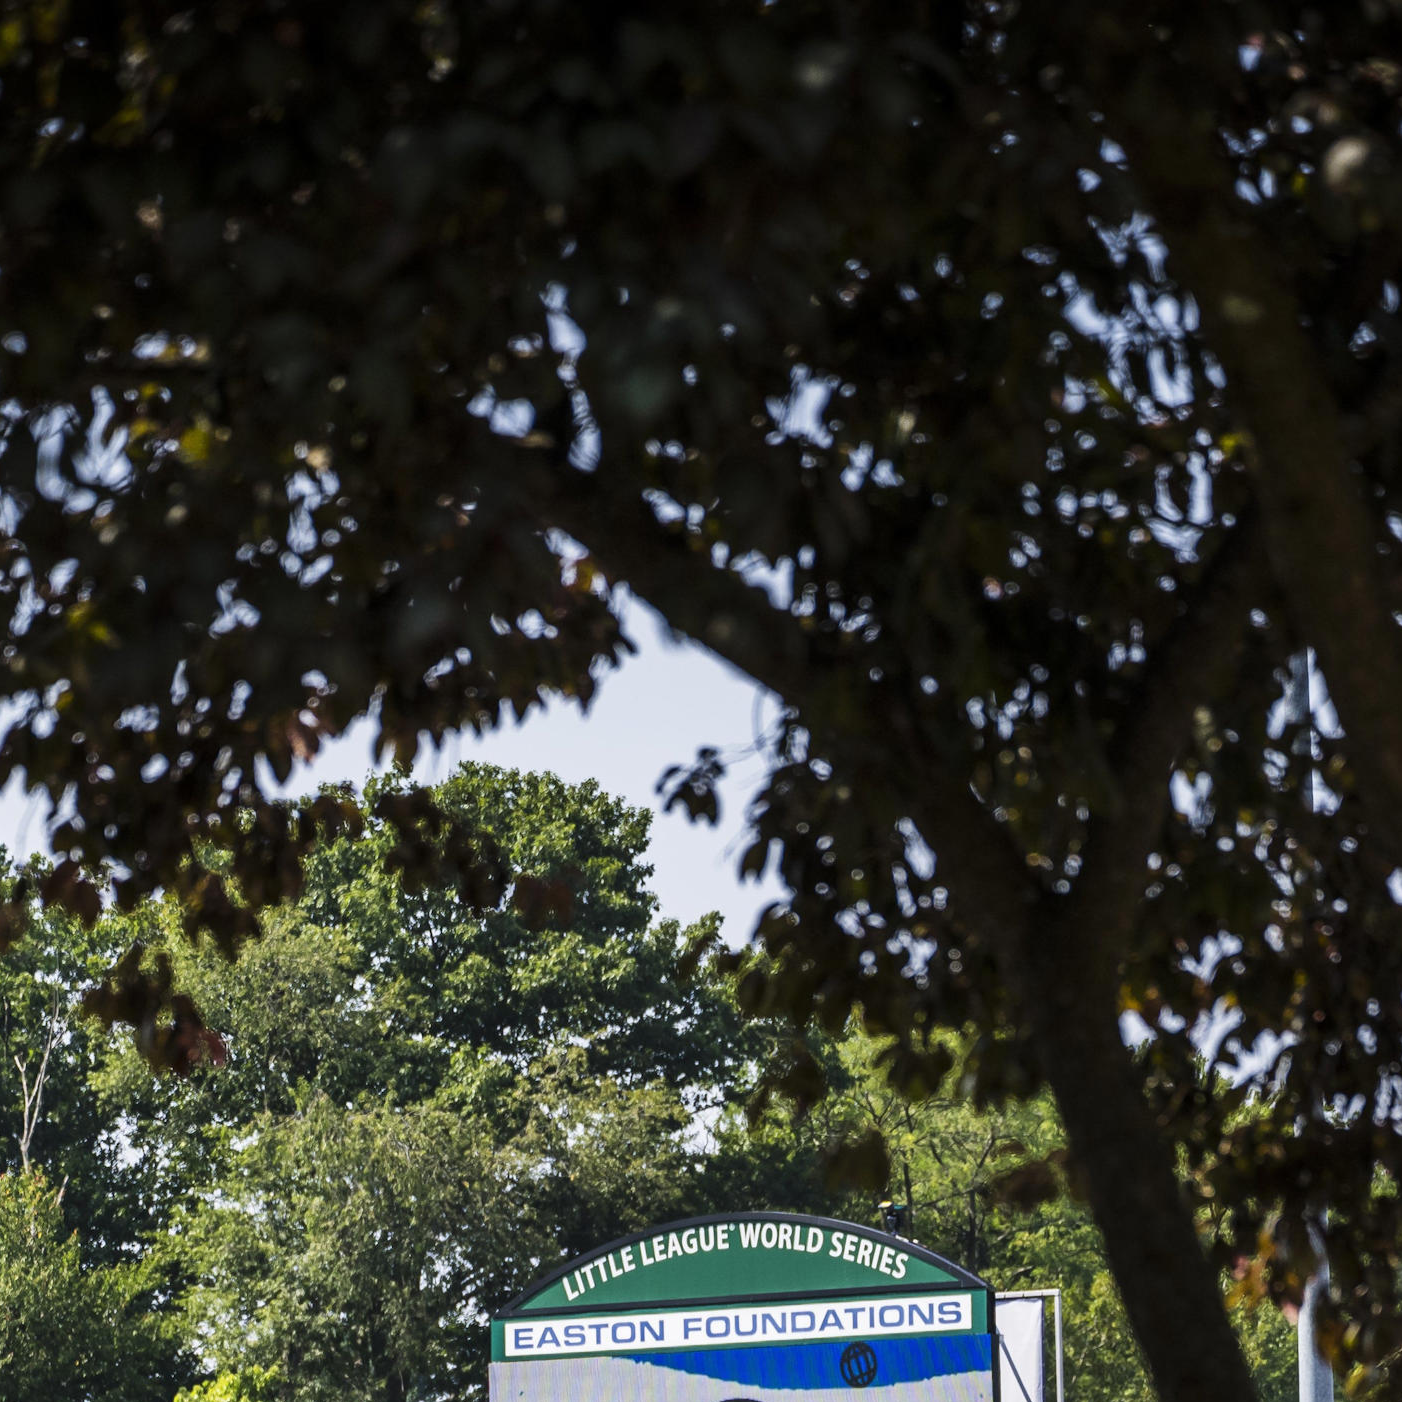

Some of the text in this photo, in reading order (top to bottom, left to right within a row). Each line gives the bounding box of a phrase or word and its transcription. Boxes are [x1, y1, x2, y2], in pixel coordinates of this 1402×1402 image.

[562, 1245, 635, 1301] LITTLE
[739, 1222, 824, 1254] WORLD
[829, 1231, 910, 1279] SERIES
[514, 1301, 962, 1350] EASTON FOUNDATIONS
